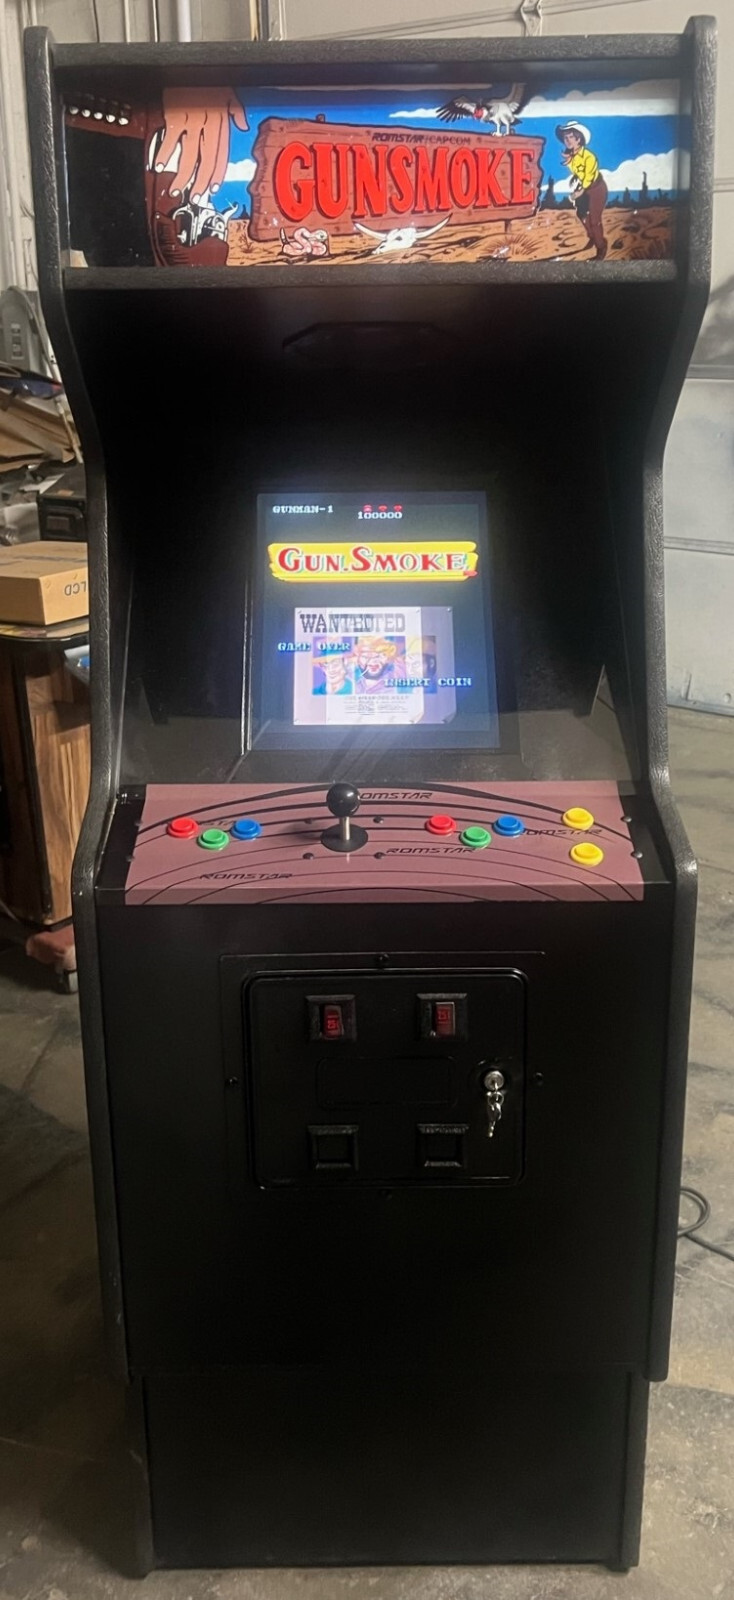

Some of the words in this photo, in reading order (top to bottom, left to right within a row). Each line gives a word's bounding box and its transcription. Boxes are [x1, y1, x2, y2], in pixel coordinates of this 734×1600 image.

[274, 141, 536, 221] GUNSMOKE
[358, 511, 403, 520] 100000
[64, 581, 87, 596] LCD
[277, 642, 311, 652] GAME
[317, 642, 351, 652] OVER
[384, 678, 430, 687] INSERT
[438, 678, 471, 687] COIN
[359, 792, 433, 800] OMSTAR
